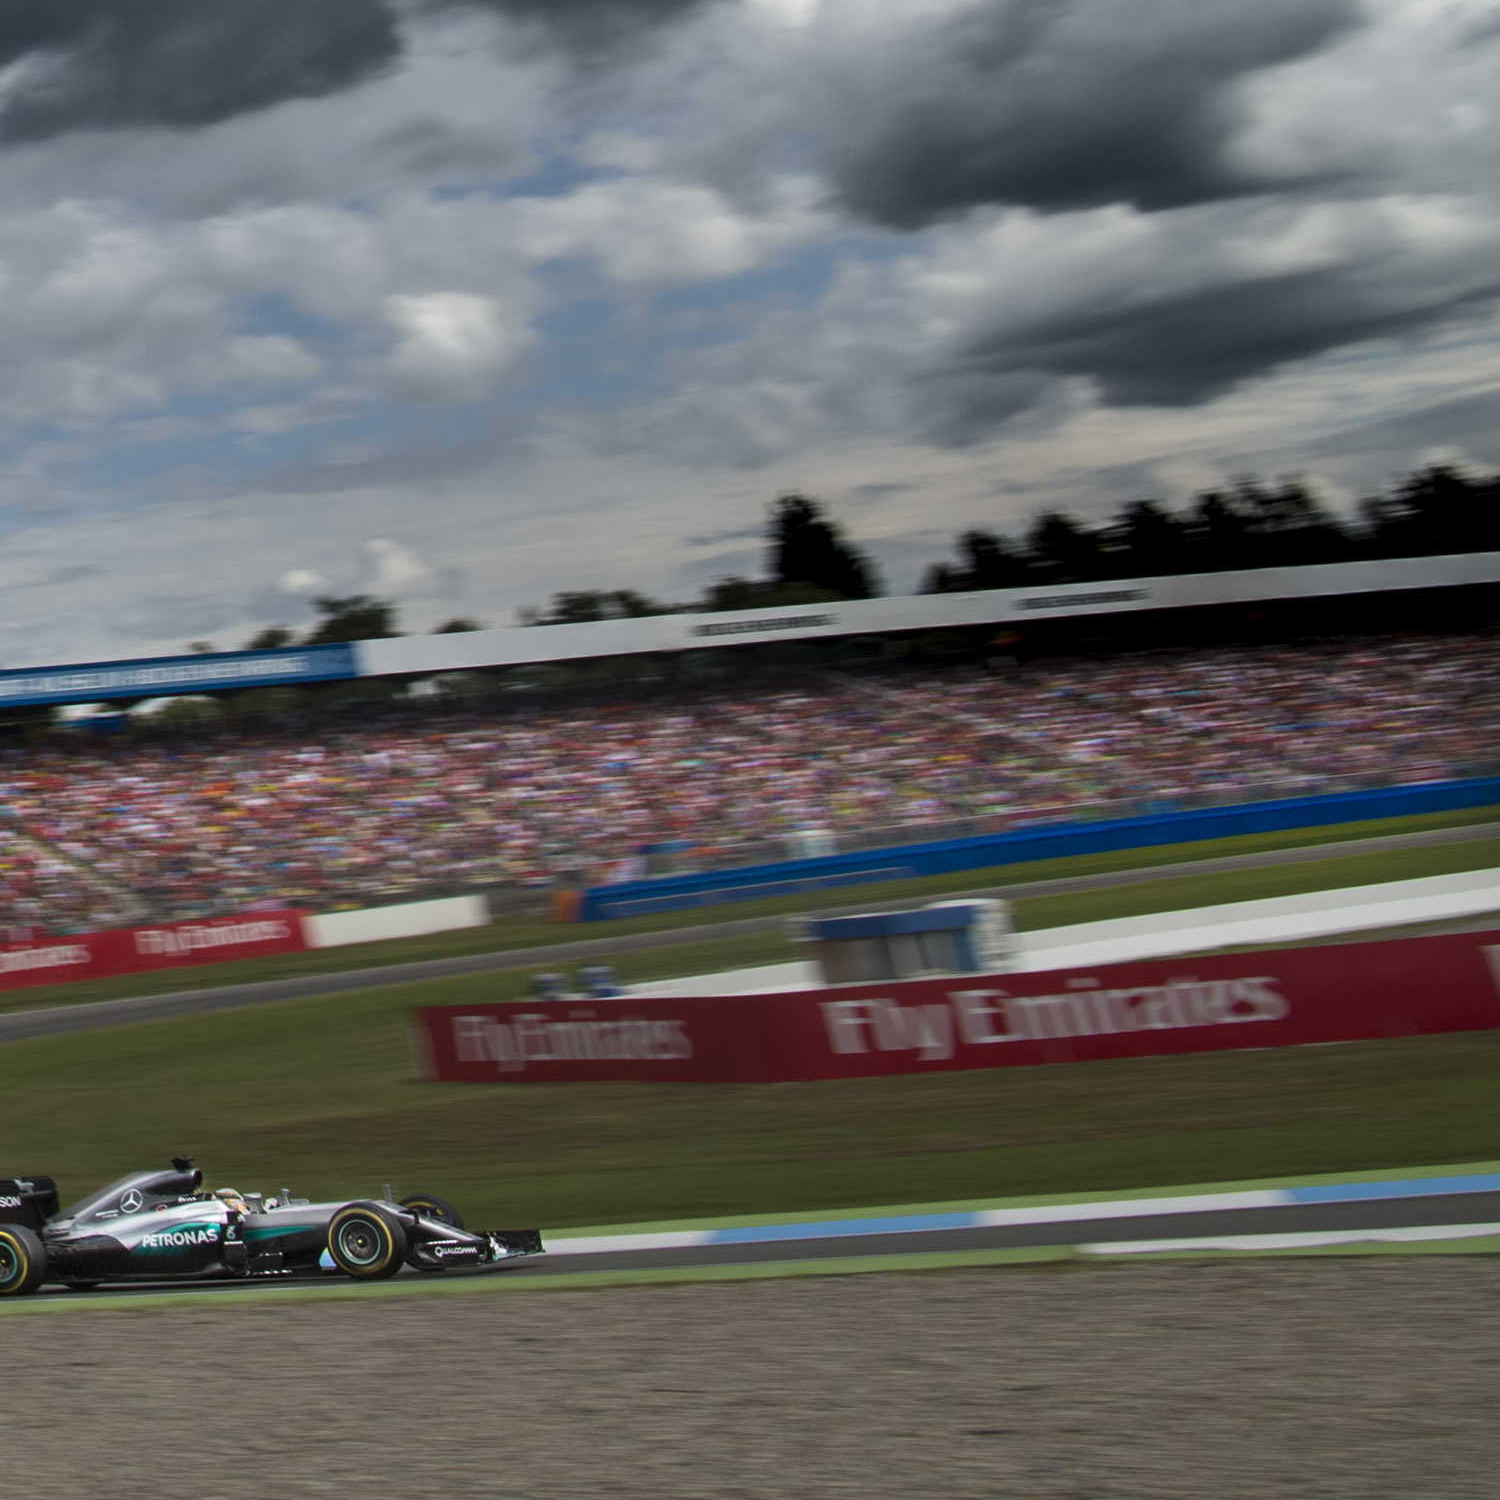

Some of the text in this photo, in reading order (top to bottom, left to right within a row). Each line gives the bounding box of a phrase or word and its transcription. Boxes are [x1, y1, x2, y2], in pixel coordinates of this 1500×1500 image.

[818, 976, 1292, 1060] Fly Emirates
[142, 1228, 219, 1247] PETRONAS
[434, 1246, 478, 1258] QUALCOMM
